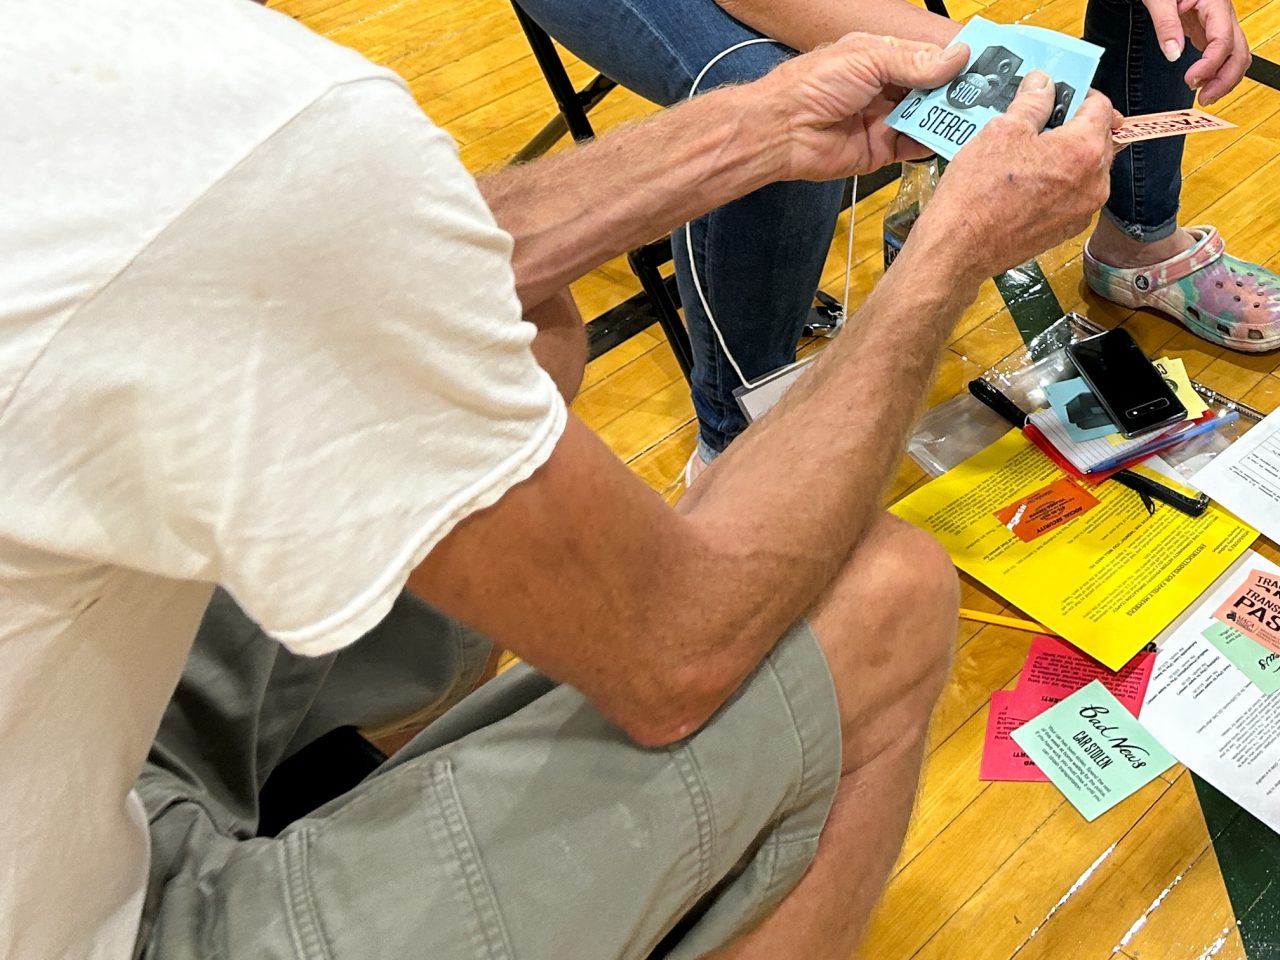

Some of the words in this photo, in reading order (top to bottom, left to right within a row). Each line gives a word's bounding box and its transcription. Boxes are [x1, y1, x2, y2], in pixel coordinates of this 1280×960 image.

[950, 80, 981, 106] $100
[918, 105, 977, 146] STEREO
[1133, 117, 1214, 130] PASS
[1036, 516, 1062, 533] SECURITY
[1062, 506, 1082, 519] SOCIAL
[1171, 543, 1207, 574] INSTRUCTIONS
[1146, 581, 1166, 598] FAMILY
[1162, 572, 1176, 582] FOR
[1125, 595, 1150, 617] MEMBERS
[1079, 703, 1111, 738] Bad
[1109, 737, 1150, 769] News
[1047, 725, 1057, 734] Your
[1060, 739, 1069, 747] has
[1066, 745, 1077, 756] been
[1074, 754, 1087, 767] stolen.
[1085, 766, 1099, 779] Spend
[1102, 784, 1111, 793] rest
[1072, 730, 1089, 749] CAR
[1084, 741, 1113, 770] STOLEN
[1050, 737, 1061, 748] week
[1062, 751, 1074, 762] home
[1071, 761, 1085, 774] waiting
[1087, 778, 1096, 786] the
[1093, 785, 1106, 797] police.
